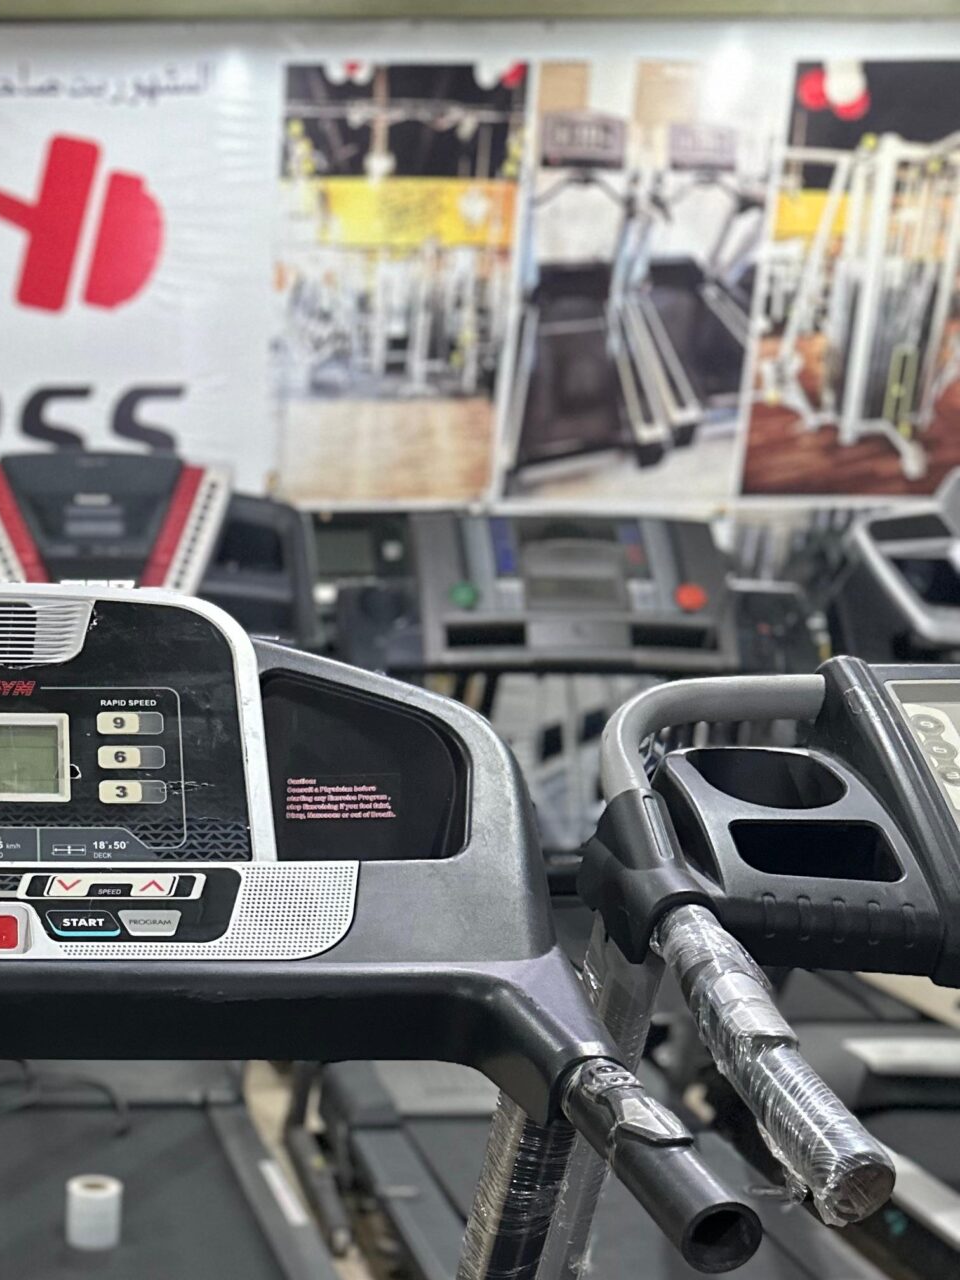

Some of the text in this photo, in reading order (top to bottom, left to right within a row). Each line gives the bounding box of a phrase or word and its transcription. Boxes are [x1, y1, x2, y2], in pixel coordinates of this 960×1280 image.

[112, 716, 126, 729] 9
[114, 750, 127, 763] 6
[115, 785, 128, 798] 3
[62, 918, 105, 927] START
